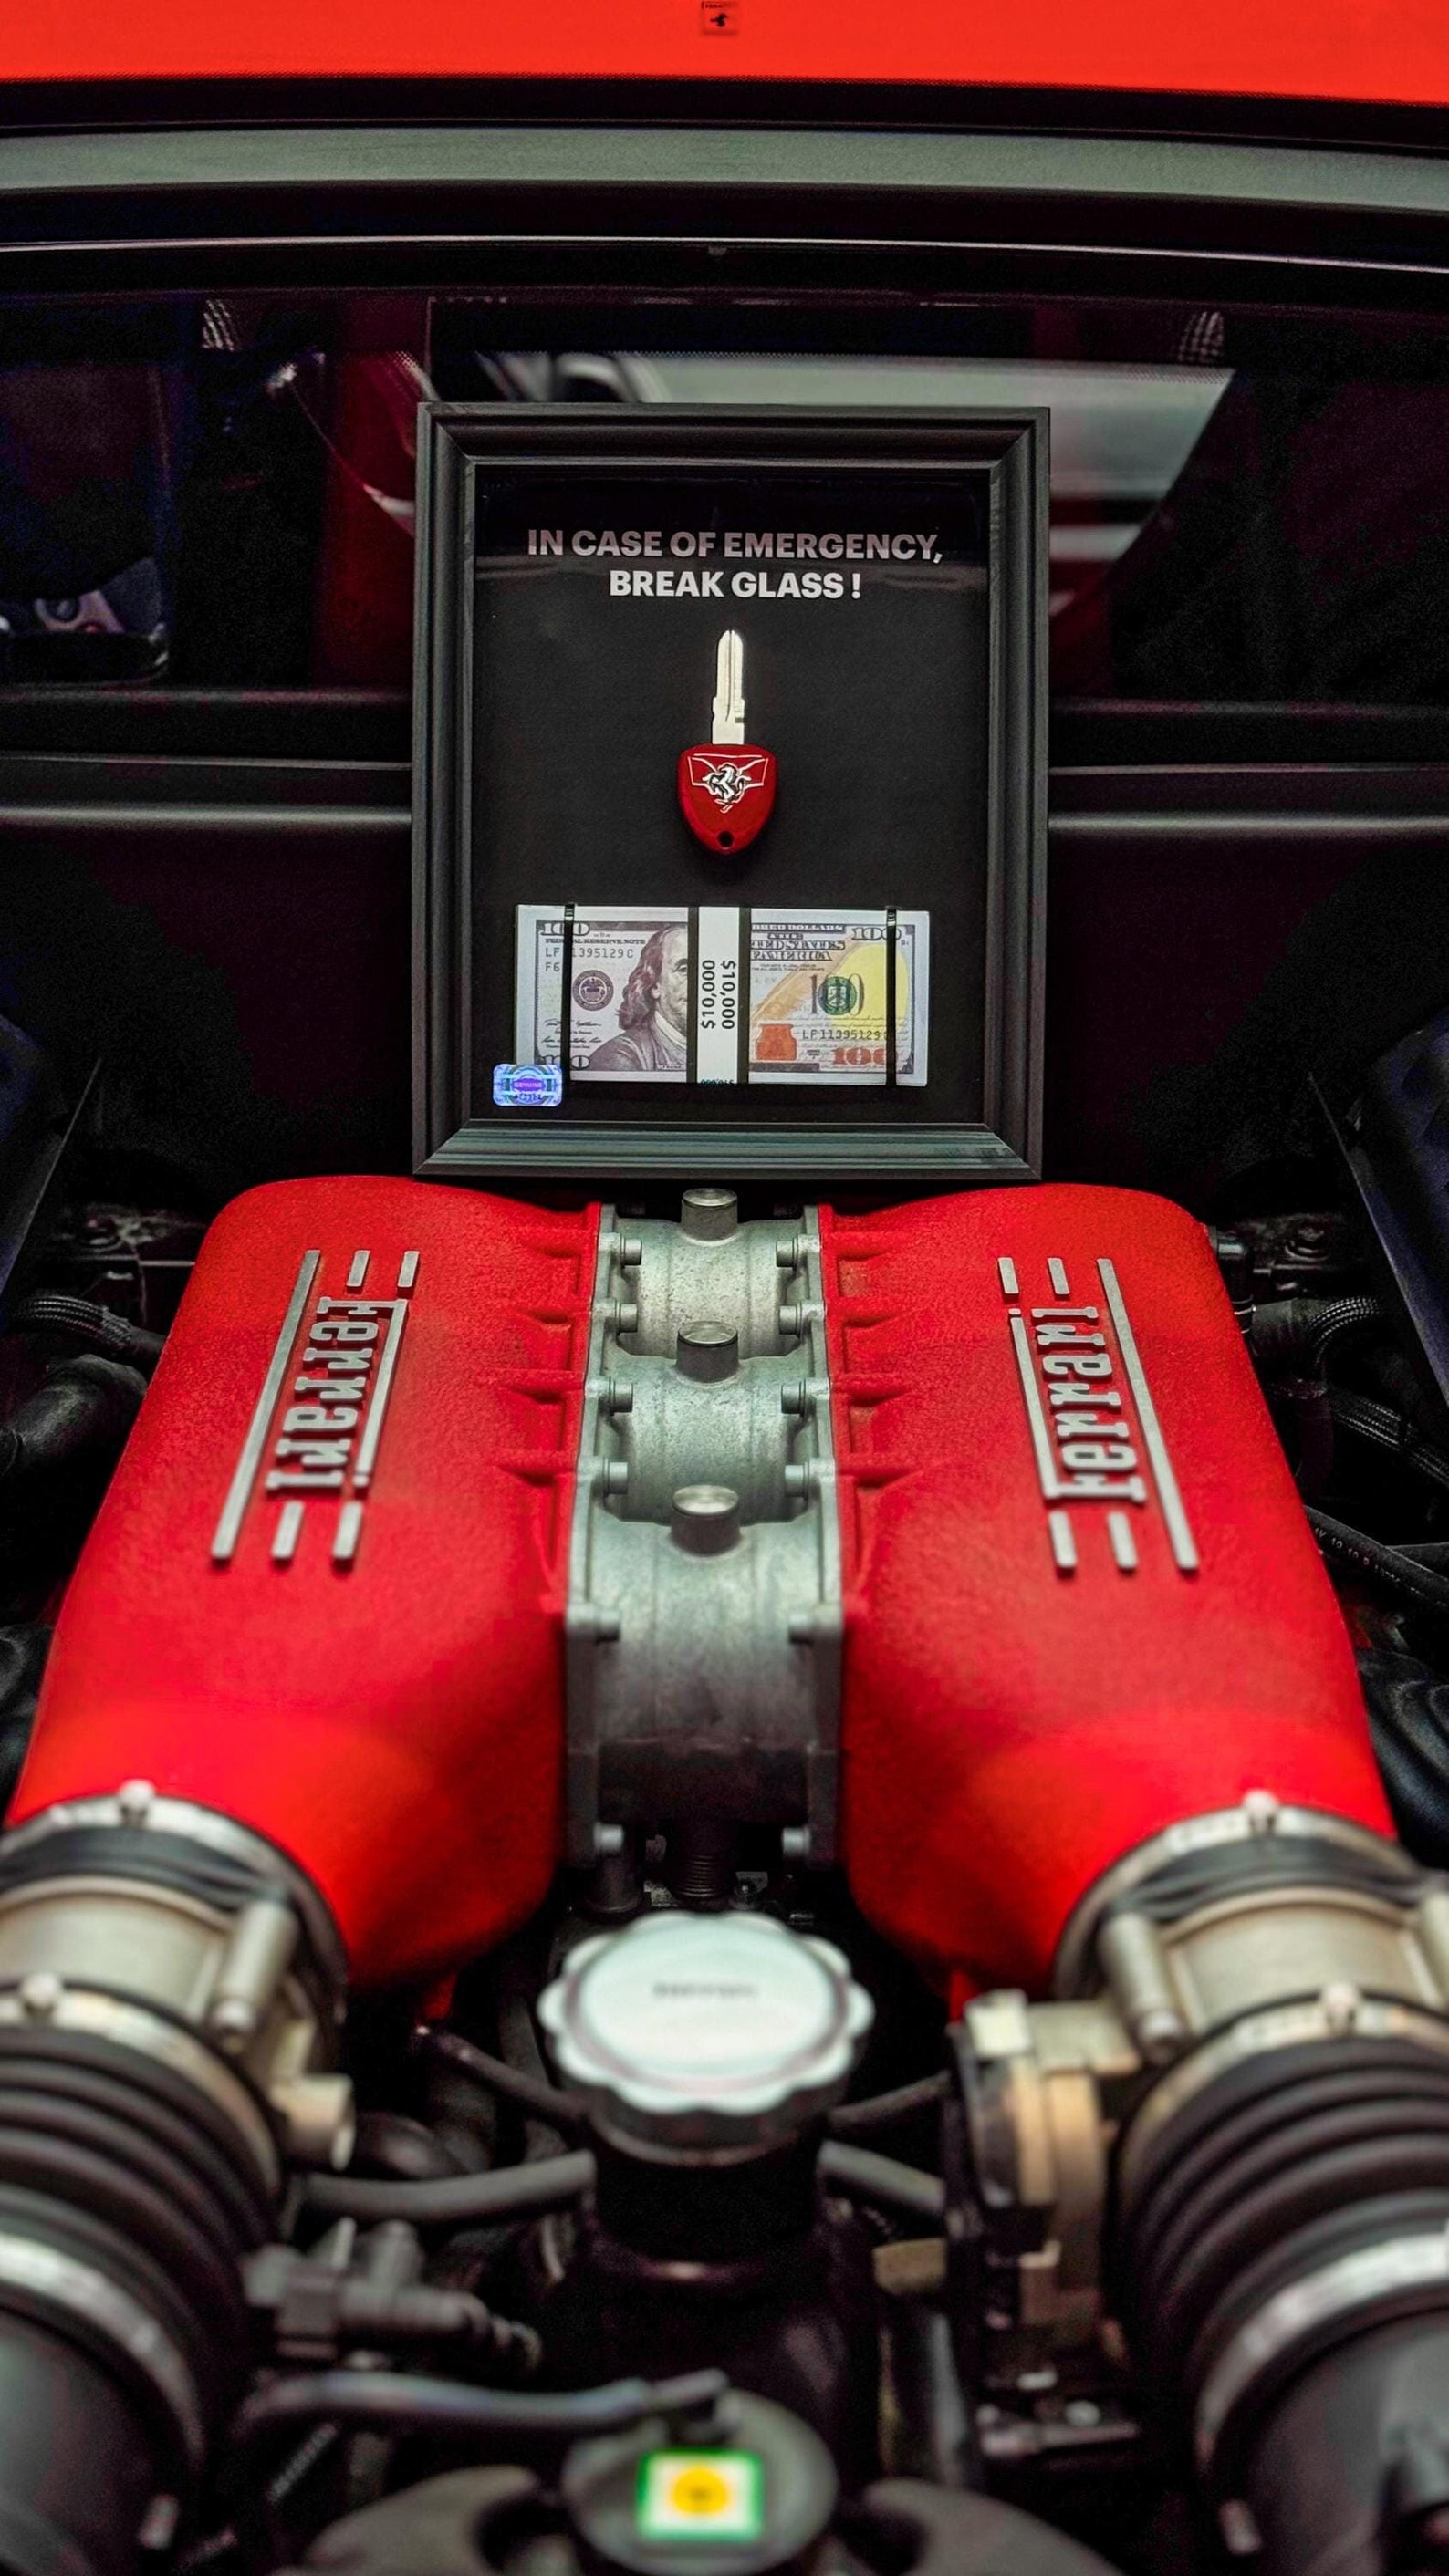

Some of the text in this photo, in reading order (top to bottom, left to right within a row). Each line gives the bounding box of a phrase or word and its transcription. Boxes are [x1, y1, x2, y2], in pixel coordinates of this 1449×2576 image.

[527, 529, 943, 564] IN CASE OF EMERGENCY,
[609, 570, 724, 597] BREAK
[731, 572, 845, 599] GLASS
[701, 959, 716, 1030] $10,000
[721, 960, 736, 1030] $10,000
[265, 1296, 410, 1491] Ferrari
[1008, 1306, 1149, 1504] Ferrari
